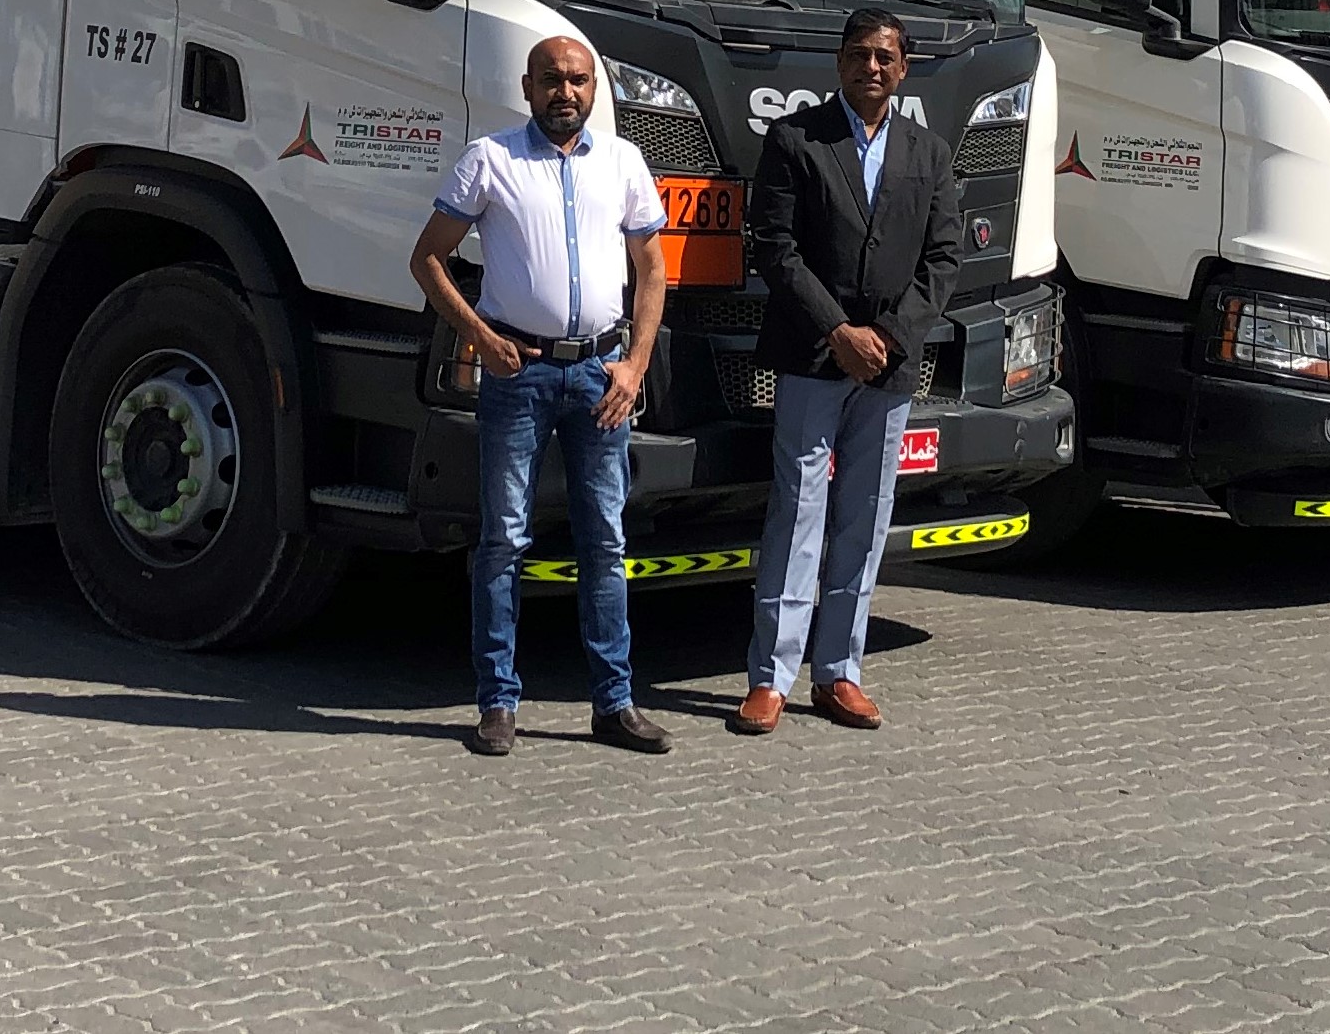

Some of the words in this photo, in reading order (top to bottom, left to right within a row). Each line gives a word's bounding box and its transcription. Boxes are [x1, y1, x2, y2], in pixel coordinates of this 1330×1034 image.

[87, 25, 110, 59] TS
[114, 28, 127, 61] #
[131, 30, 157, 64] 27
[748, 87, 929, 135] SCA
[337, 123, 442, 141] TRISTAR
[335, 139, 366, 150] FREIGHT
[367, 141, 382, 151] AND
[384, 143, 421, 154] LOGISTICS
[1103, 148, 1201, 166] TRISTAR
[1132, 164, 1146, 172] AND
[1147, 166, 1183, 175] LOGISTICS
[660, 187, 730, 228] 1268
